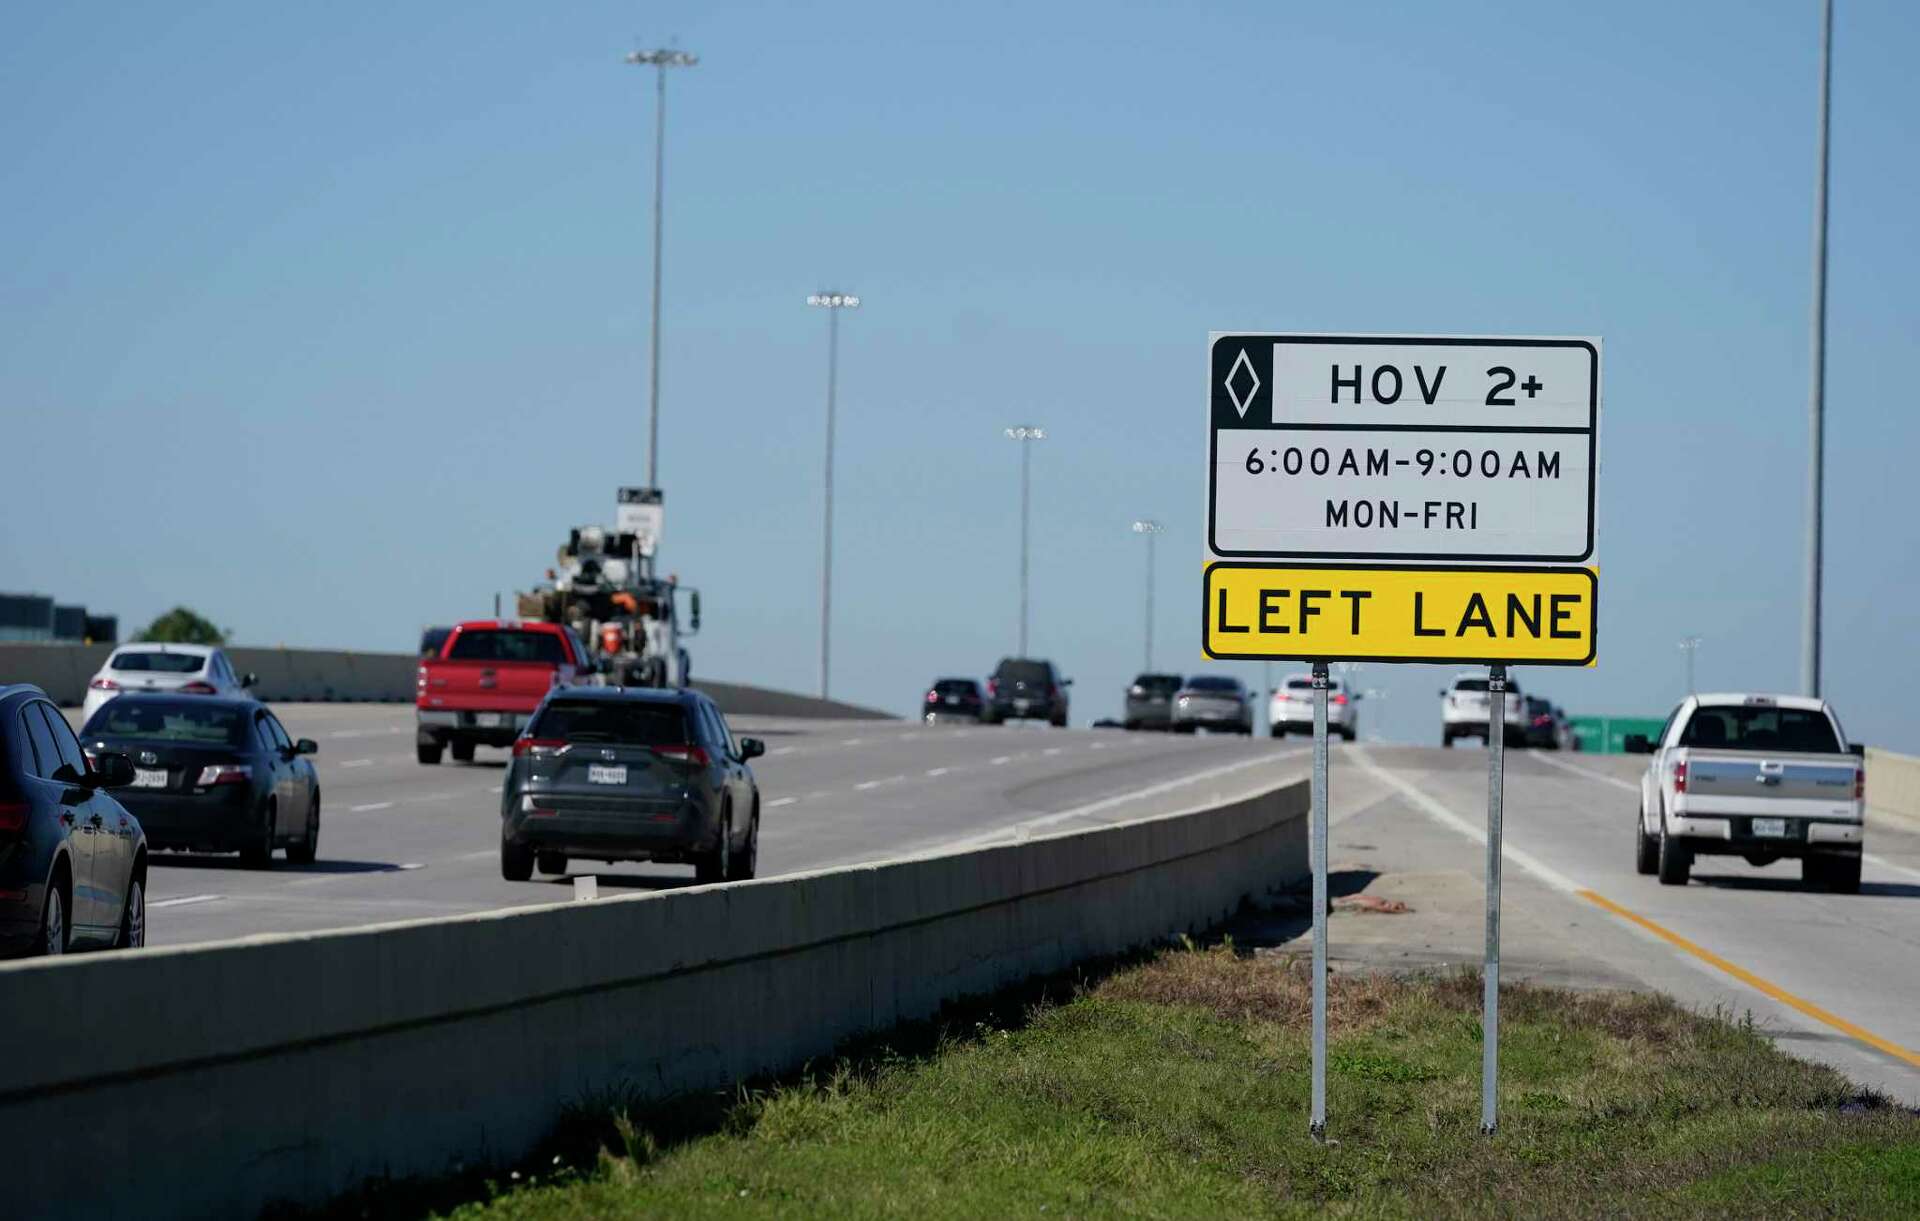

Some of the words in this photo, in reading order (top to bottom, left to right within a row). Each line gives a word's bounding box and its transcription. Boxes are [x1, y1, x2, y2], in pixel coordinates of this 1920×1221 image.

[1331, 364, 1448, 405] HOV
[1485, 366, 1543, 406] 2+
[1245, 447, 1561, 479] 6:00AM-9:00AM
[1325, 500, 1477, 530] MON-FRI
[1218, 588, 1372, 635] LEFT
[1414, 592, 1582, 639] LANE
